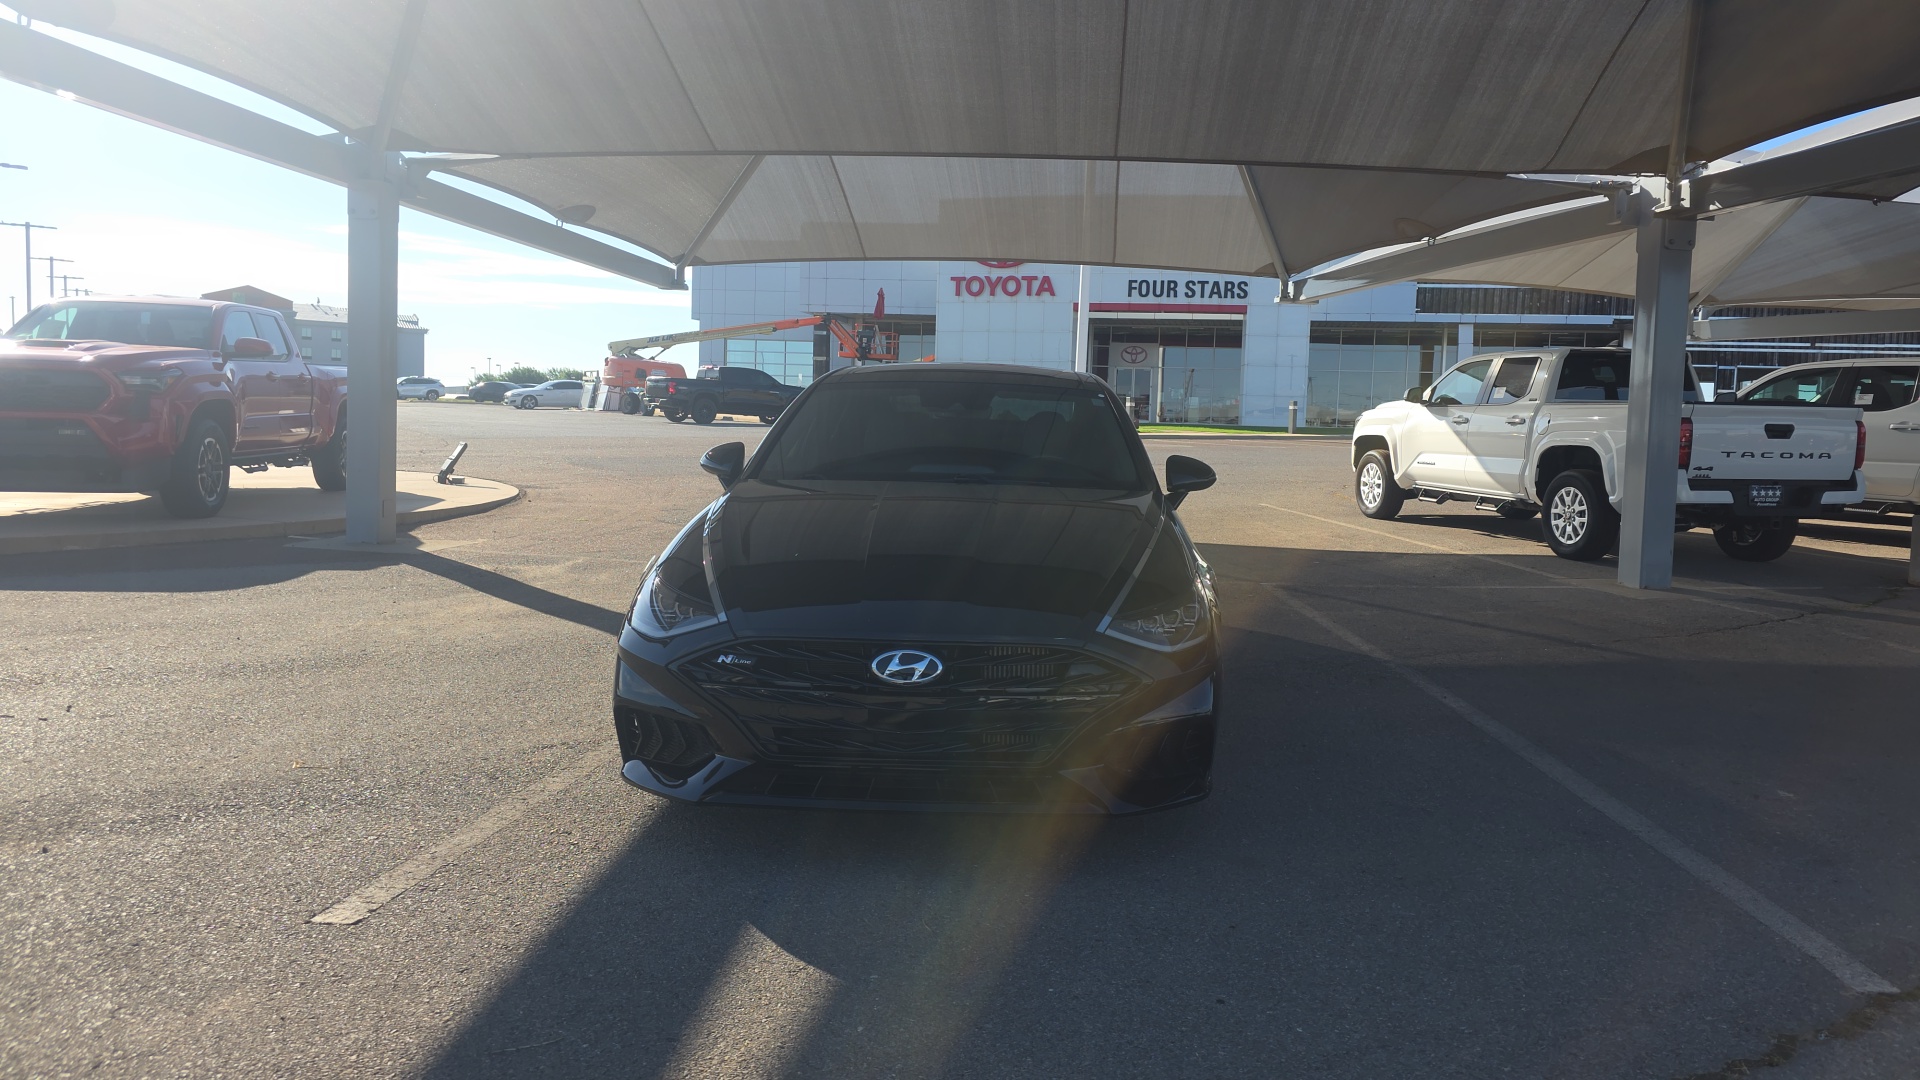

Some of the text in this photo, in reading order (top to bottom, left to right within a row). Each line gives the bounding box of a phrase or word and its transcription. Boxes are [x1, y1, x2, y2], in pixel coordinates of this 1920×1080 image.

[950, 275, 1056, 296] TOYOTA
[1127, 279, 1249, 299] FOUR STARS
[1721, 451, 1831, 459] TACOMA
[717, 654, 733, 664] N
